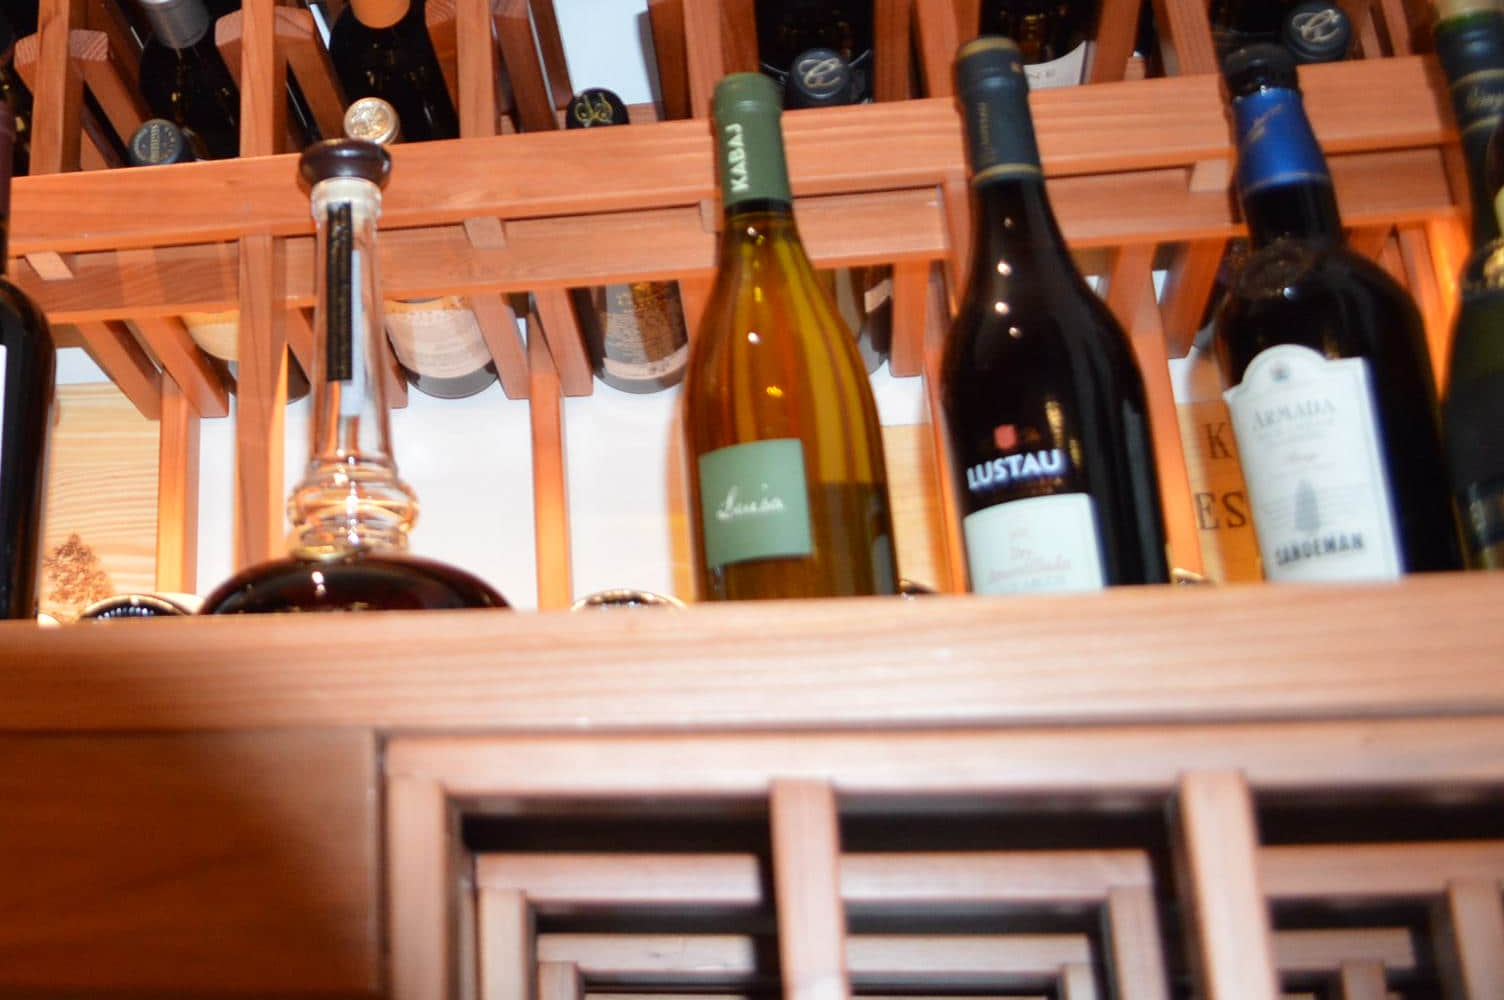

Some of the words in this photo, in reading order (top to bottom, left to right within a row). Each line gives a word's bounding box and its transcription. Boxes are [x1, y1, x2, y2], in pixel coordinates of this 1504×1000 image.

[725, 123, 750, 193] KABAJ
[966, 448, 1062, 489] LUSTAU
[1275, 532, 1364, 566] SANDEMAN
